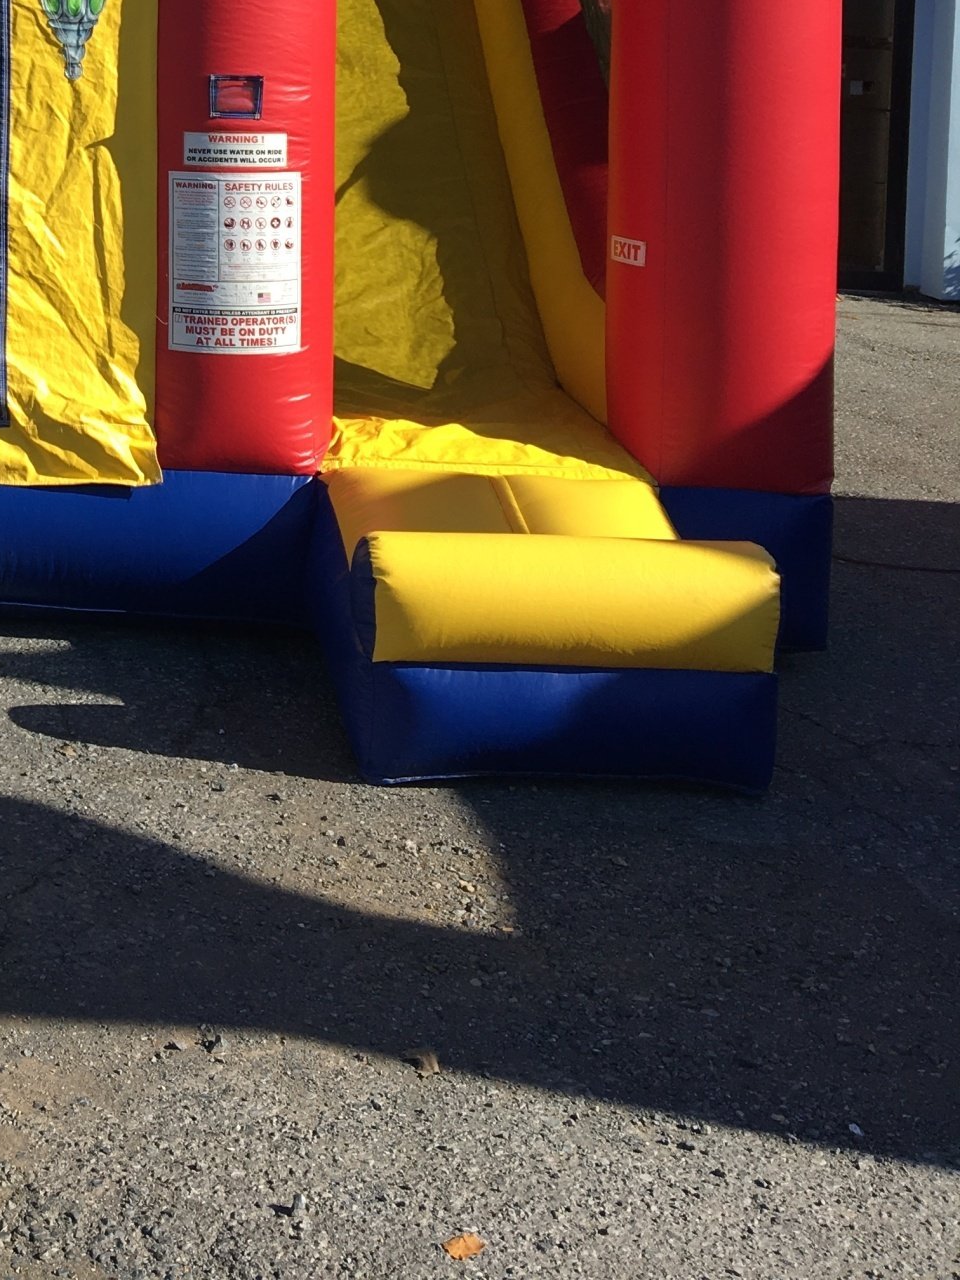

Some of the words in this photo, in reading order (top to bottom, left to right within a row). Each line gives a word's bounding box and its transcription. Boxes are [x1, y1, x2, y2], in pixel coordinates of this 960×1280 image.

[224, 182, 263, 192] SAFETY
[265, 182, 294, 191] RULES
[613, 239, 641, 261] EXIT
[183, 315, 228, 326] TRAINED
[230, 315, 296, 326] OPERATOR(S)
[185, 326, 217, 336] MUST
[220, 327, 236, 336] BE
[238, 327, 256, 337] ON
[258, 326, 287, 336] DUTY
[195, 336, 212, 346] AT
[214, 337, 237, 346] ALL
[239, 337, 277, 347] TIMES!
